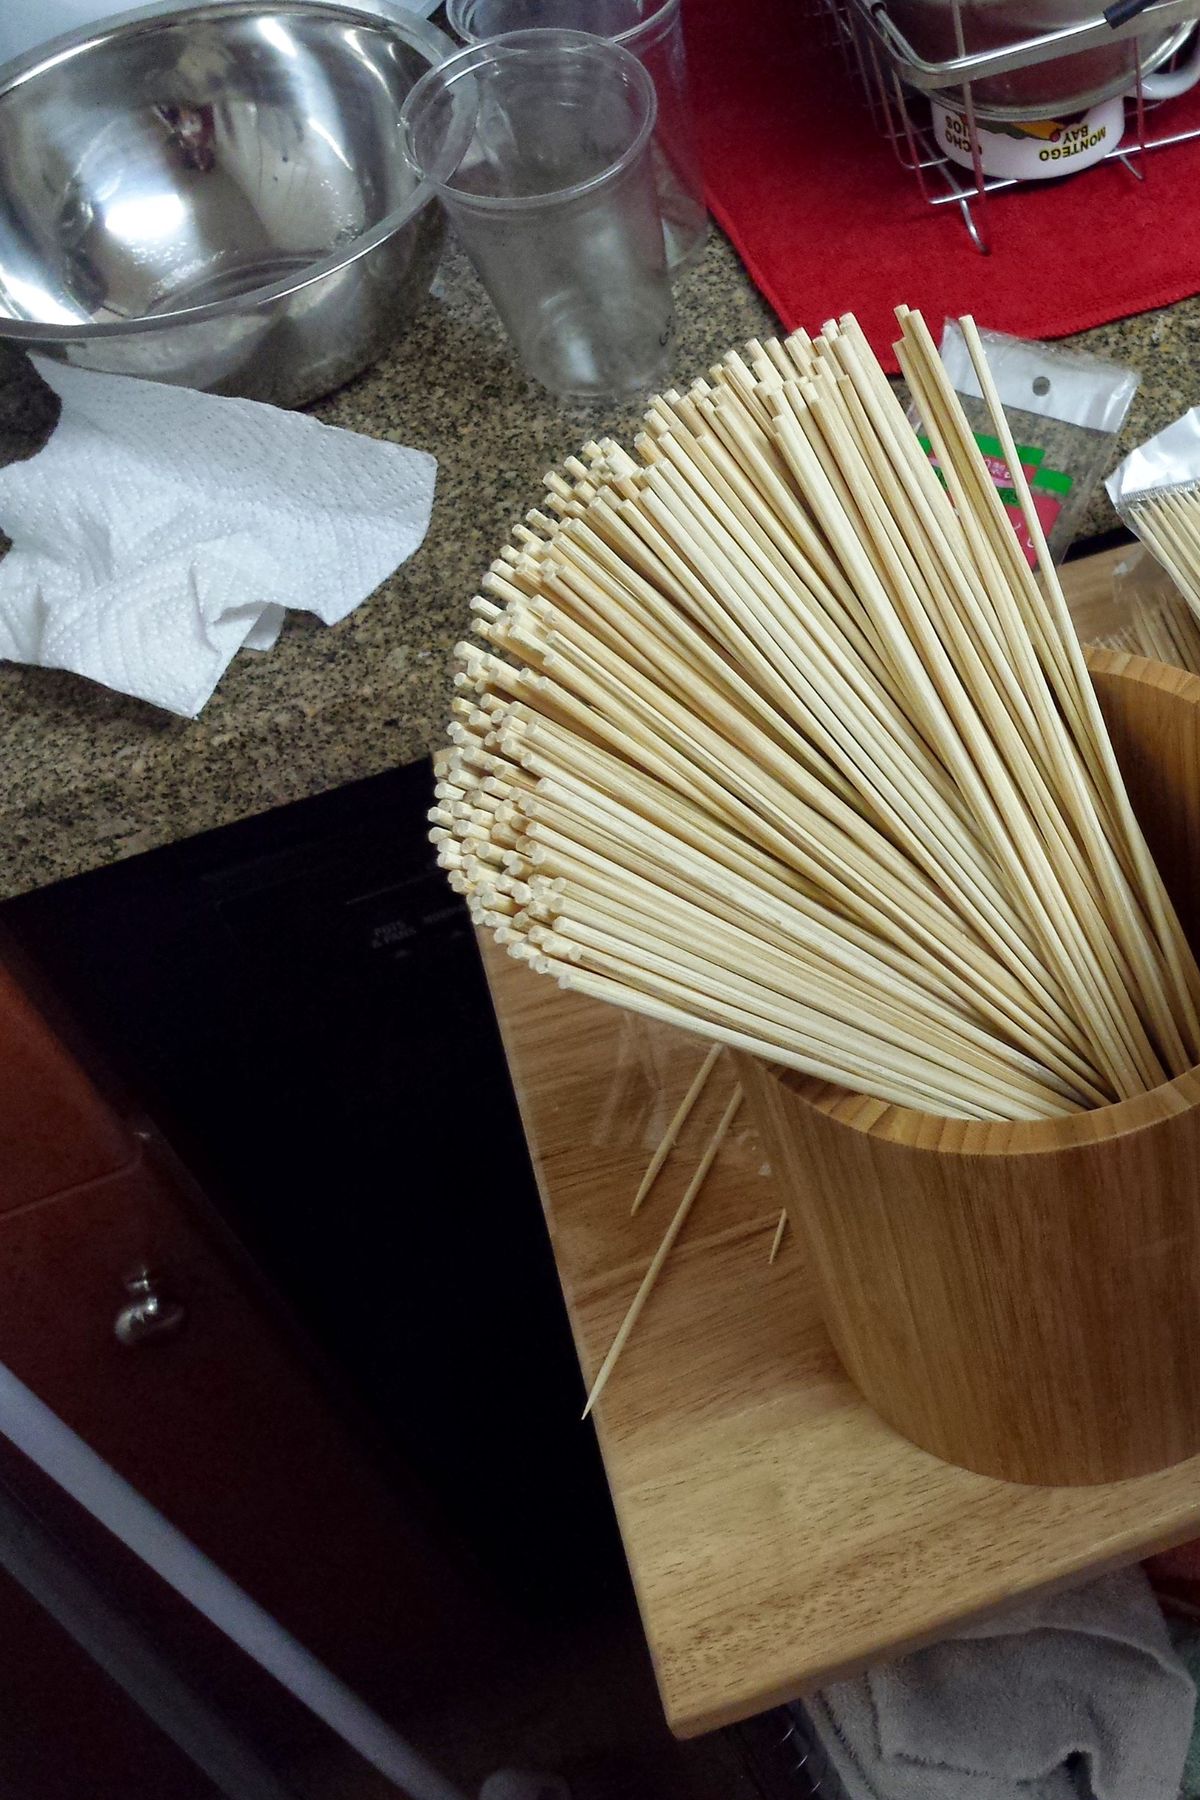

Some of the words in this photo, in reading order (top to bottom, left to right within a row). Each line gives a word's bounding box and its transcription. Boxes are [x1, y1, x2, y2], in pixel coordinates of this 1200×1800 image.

[945, 115, 969, 137] IOS
[1062, 124, 1089, 144] BAY
[945, 130, 982, 155] CHO
[1039, 126, 1107, 161] MONTEGO
